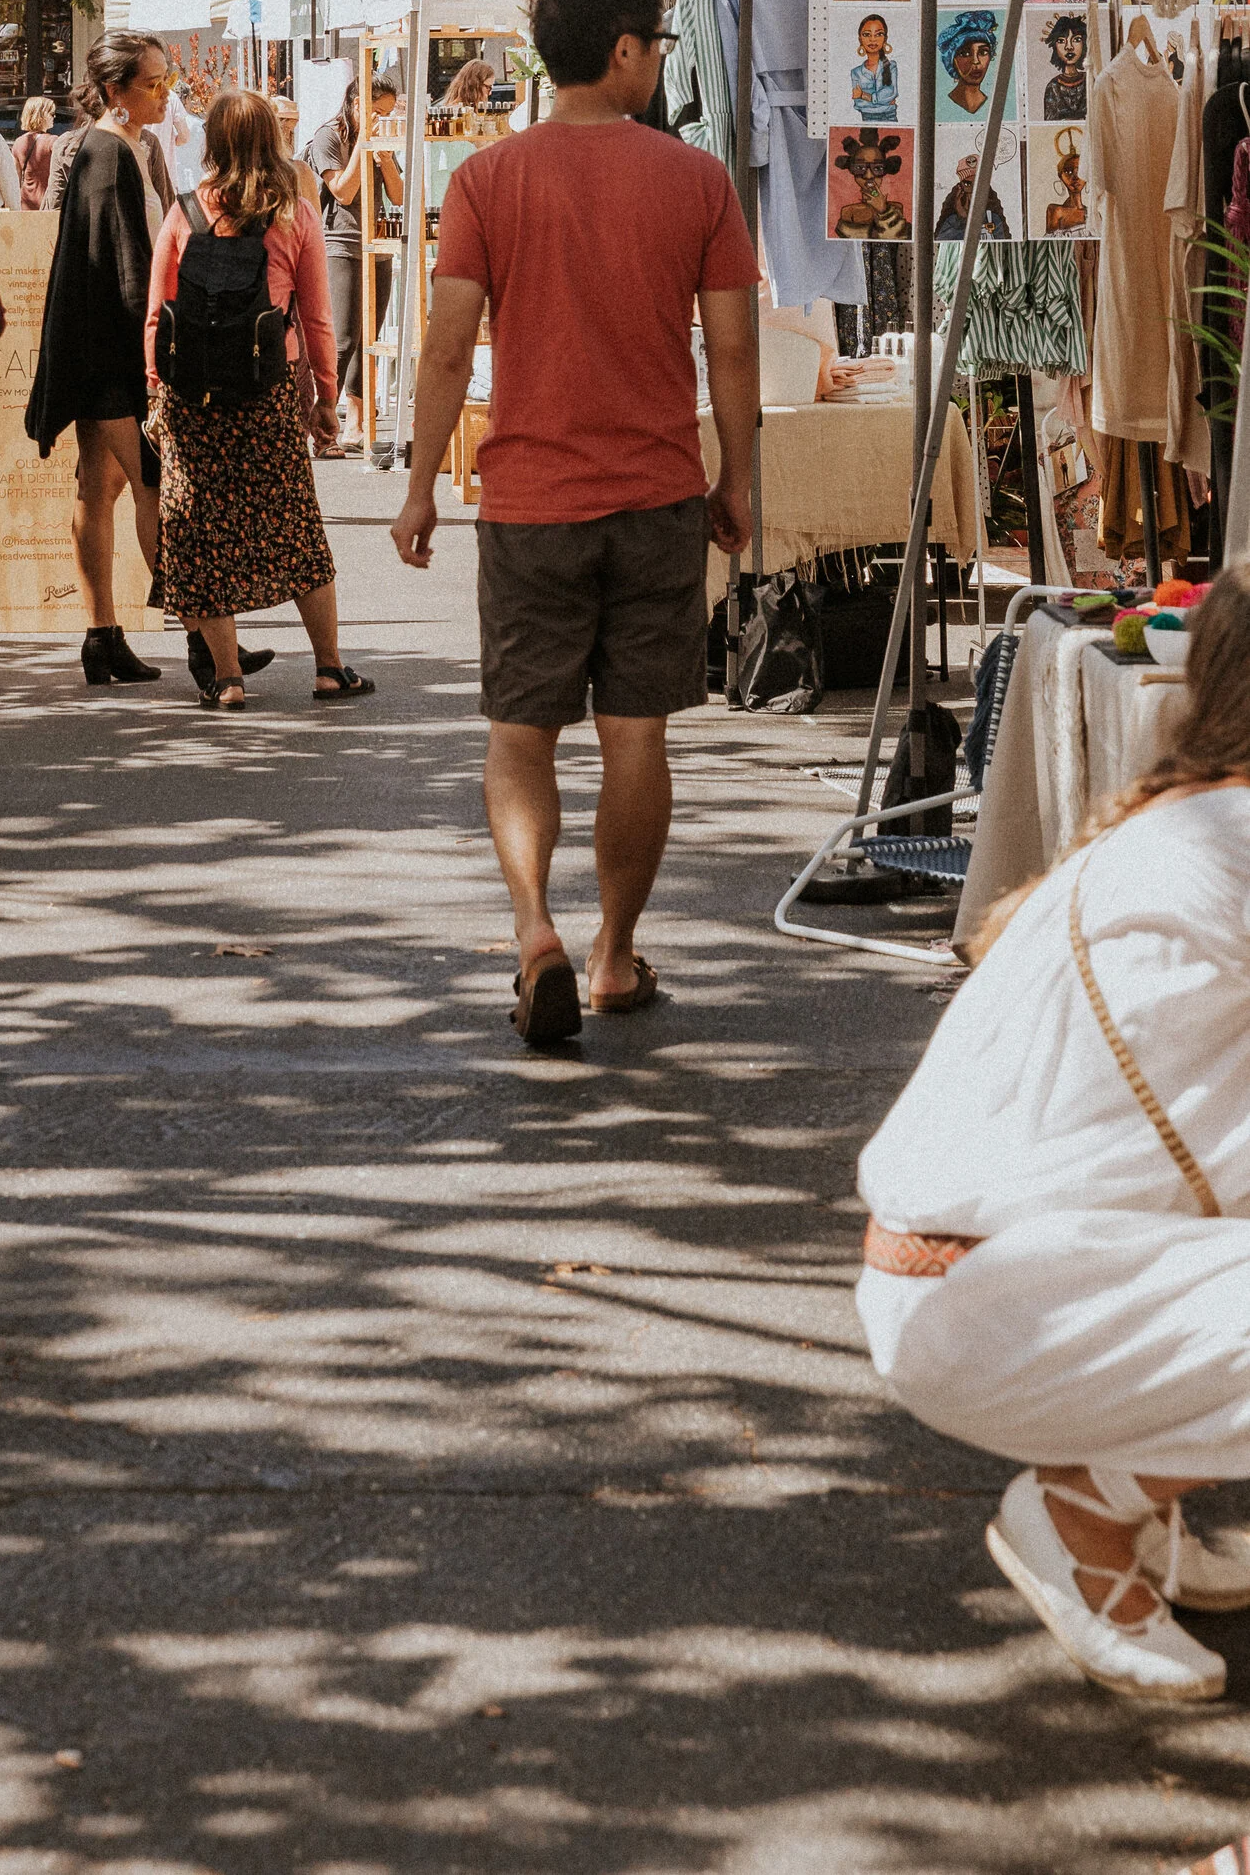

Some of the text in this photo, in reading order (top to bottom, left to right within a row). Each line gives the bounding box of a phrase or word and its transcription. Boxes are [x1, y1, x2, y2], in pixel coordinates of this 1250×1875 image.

[15, 267, 46, 275] makers
[7, 280, 36, 290] vintage
[15, 459, 40, 470] OLD
[27, 473, 78, 484] DISTILLE
[31, 487, 73, 498] STREET
[43, 583, 79, 602] Revive
